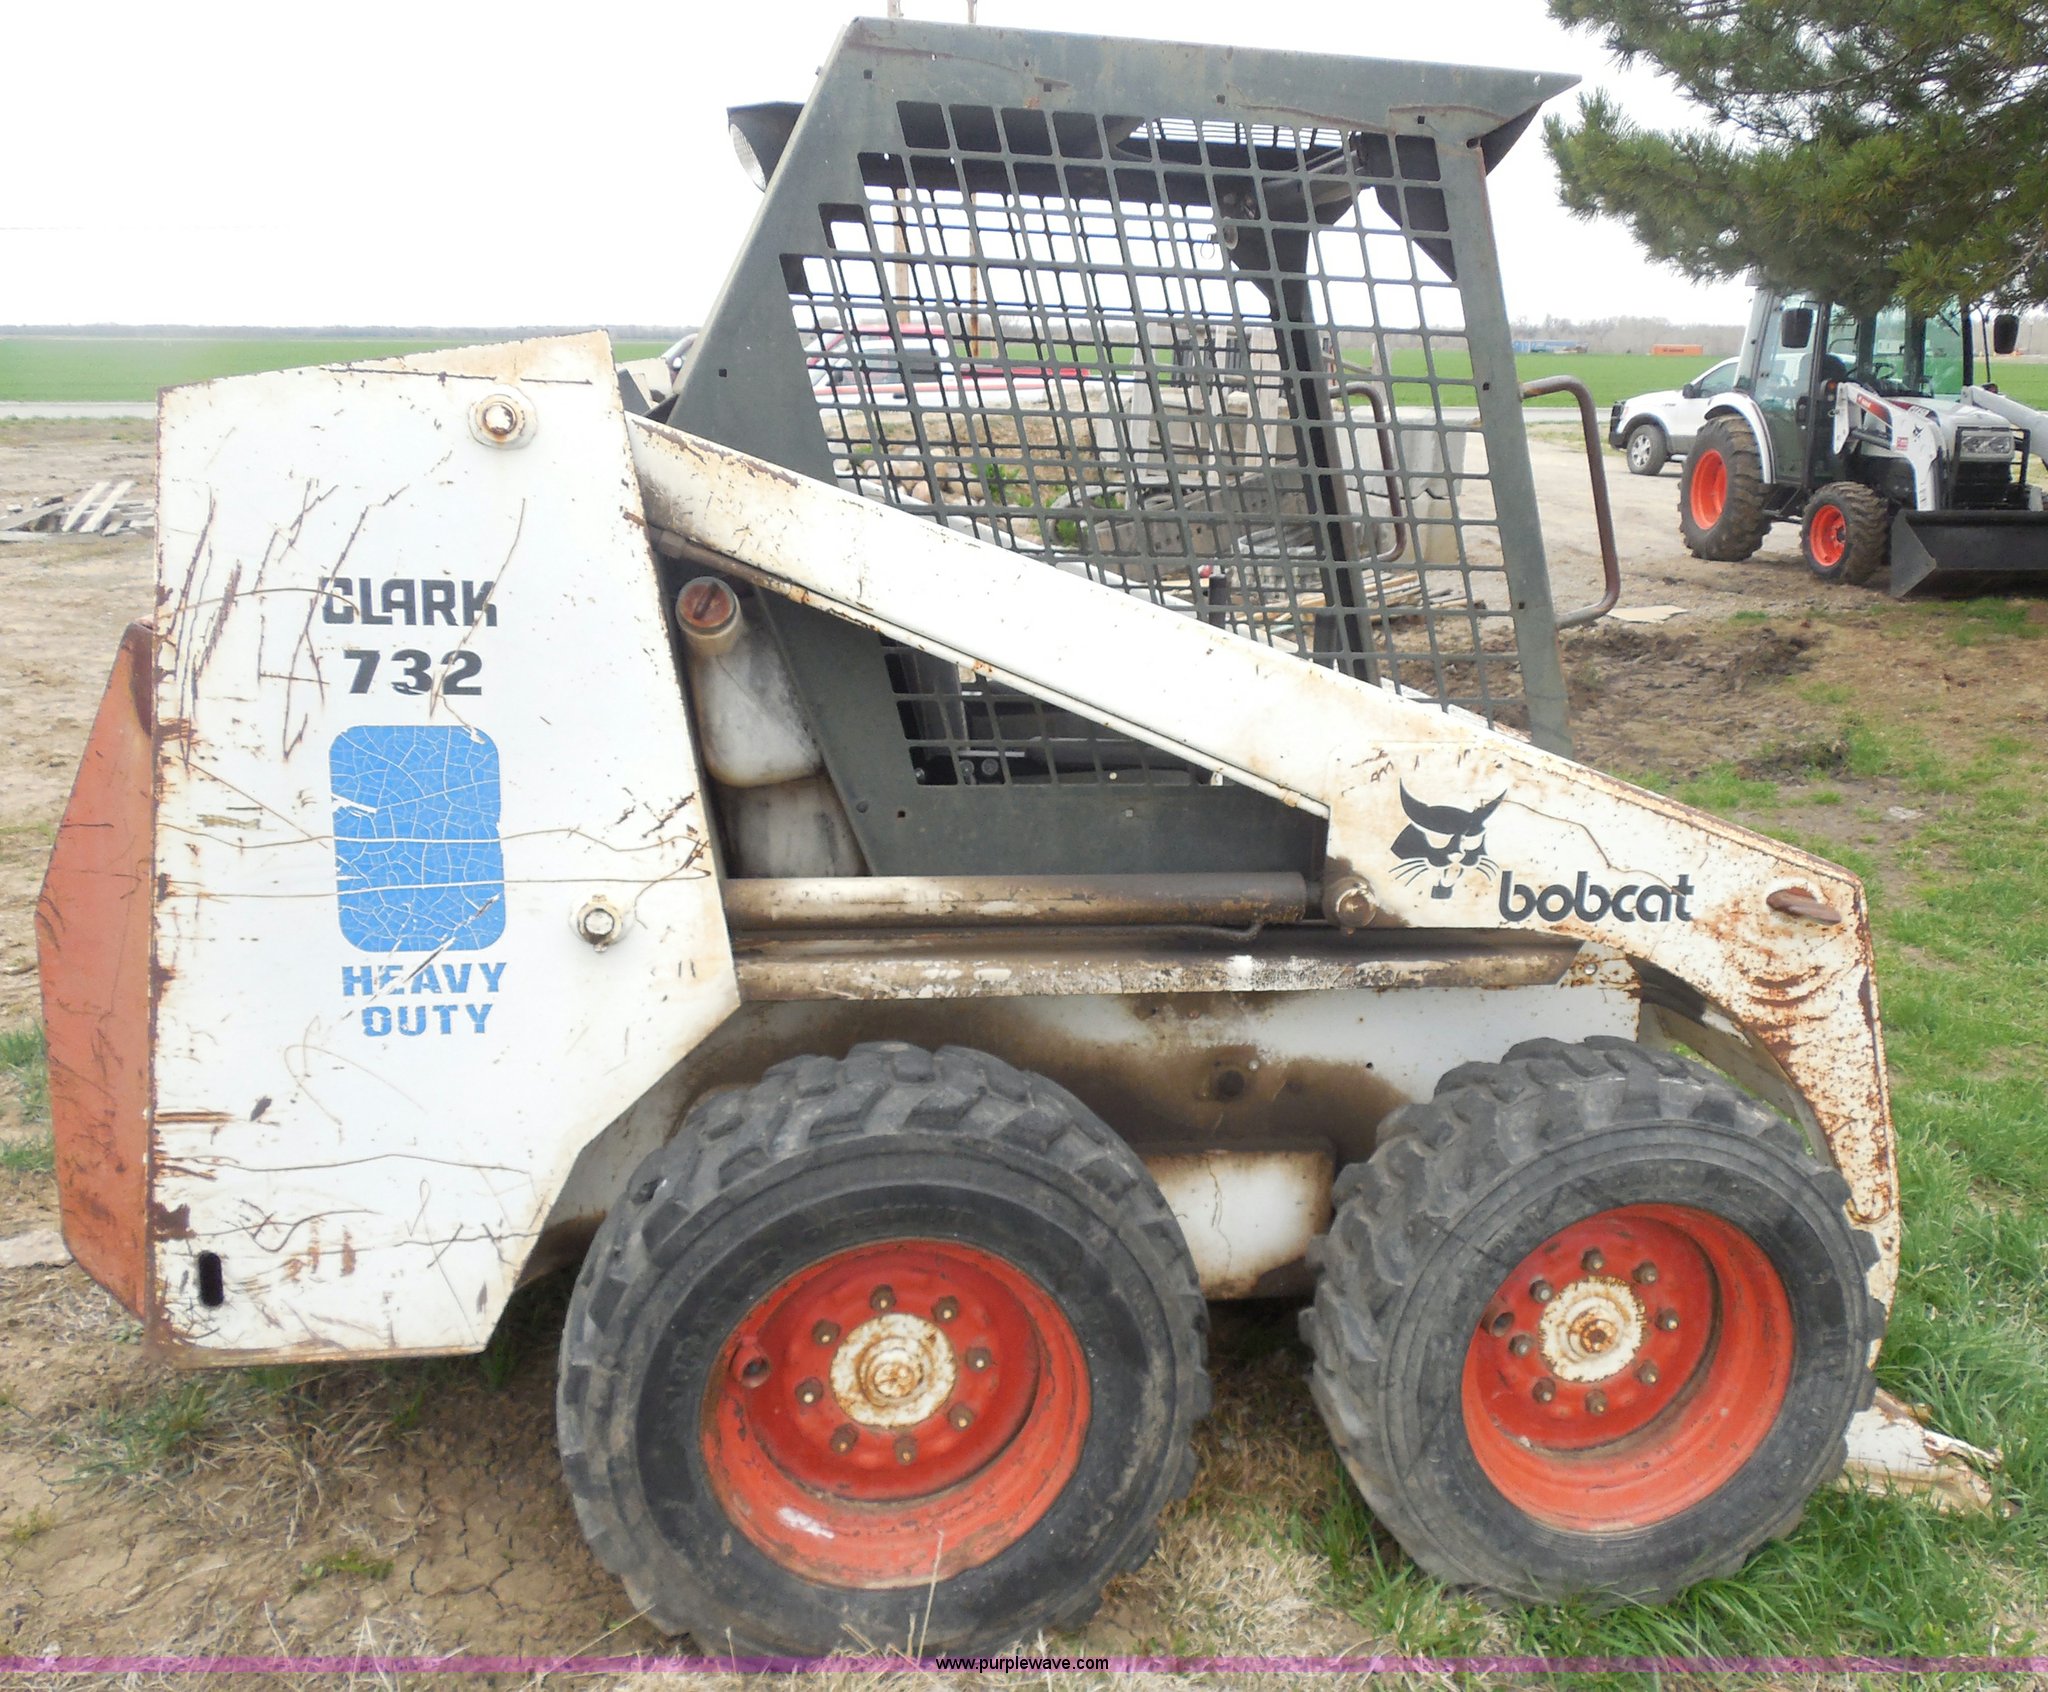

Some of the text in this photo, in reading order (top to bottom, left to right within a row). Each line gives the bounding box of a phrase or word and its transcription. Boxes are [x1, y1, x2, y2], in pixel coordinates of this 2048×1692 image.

[321, 577, 498, 627] CLARK
[343, 648, 483, 696] 732
[1498, 870, 1695, 923] bobcat
[341, 962, 507, 997] HEAVY
[361, 1003, 493, 1037] DUTY
